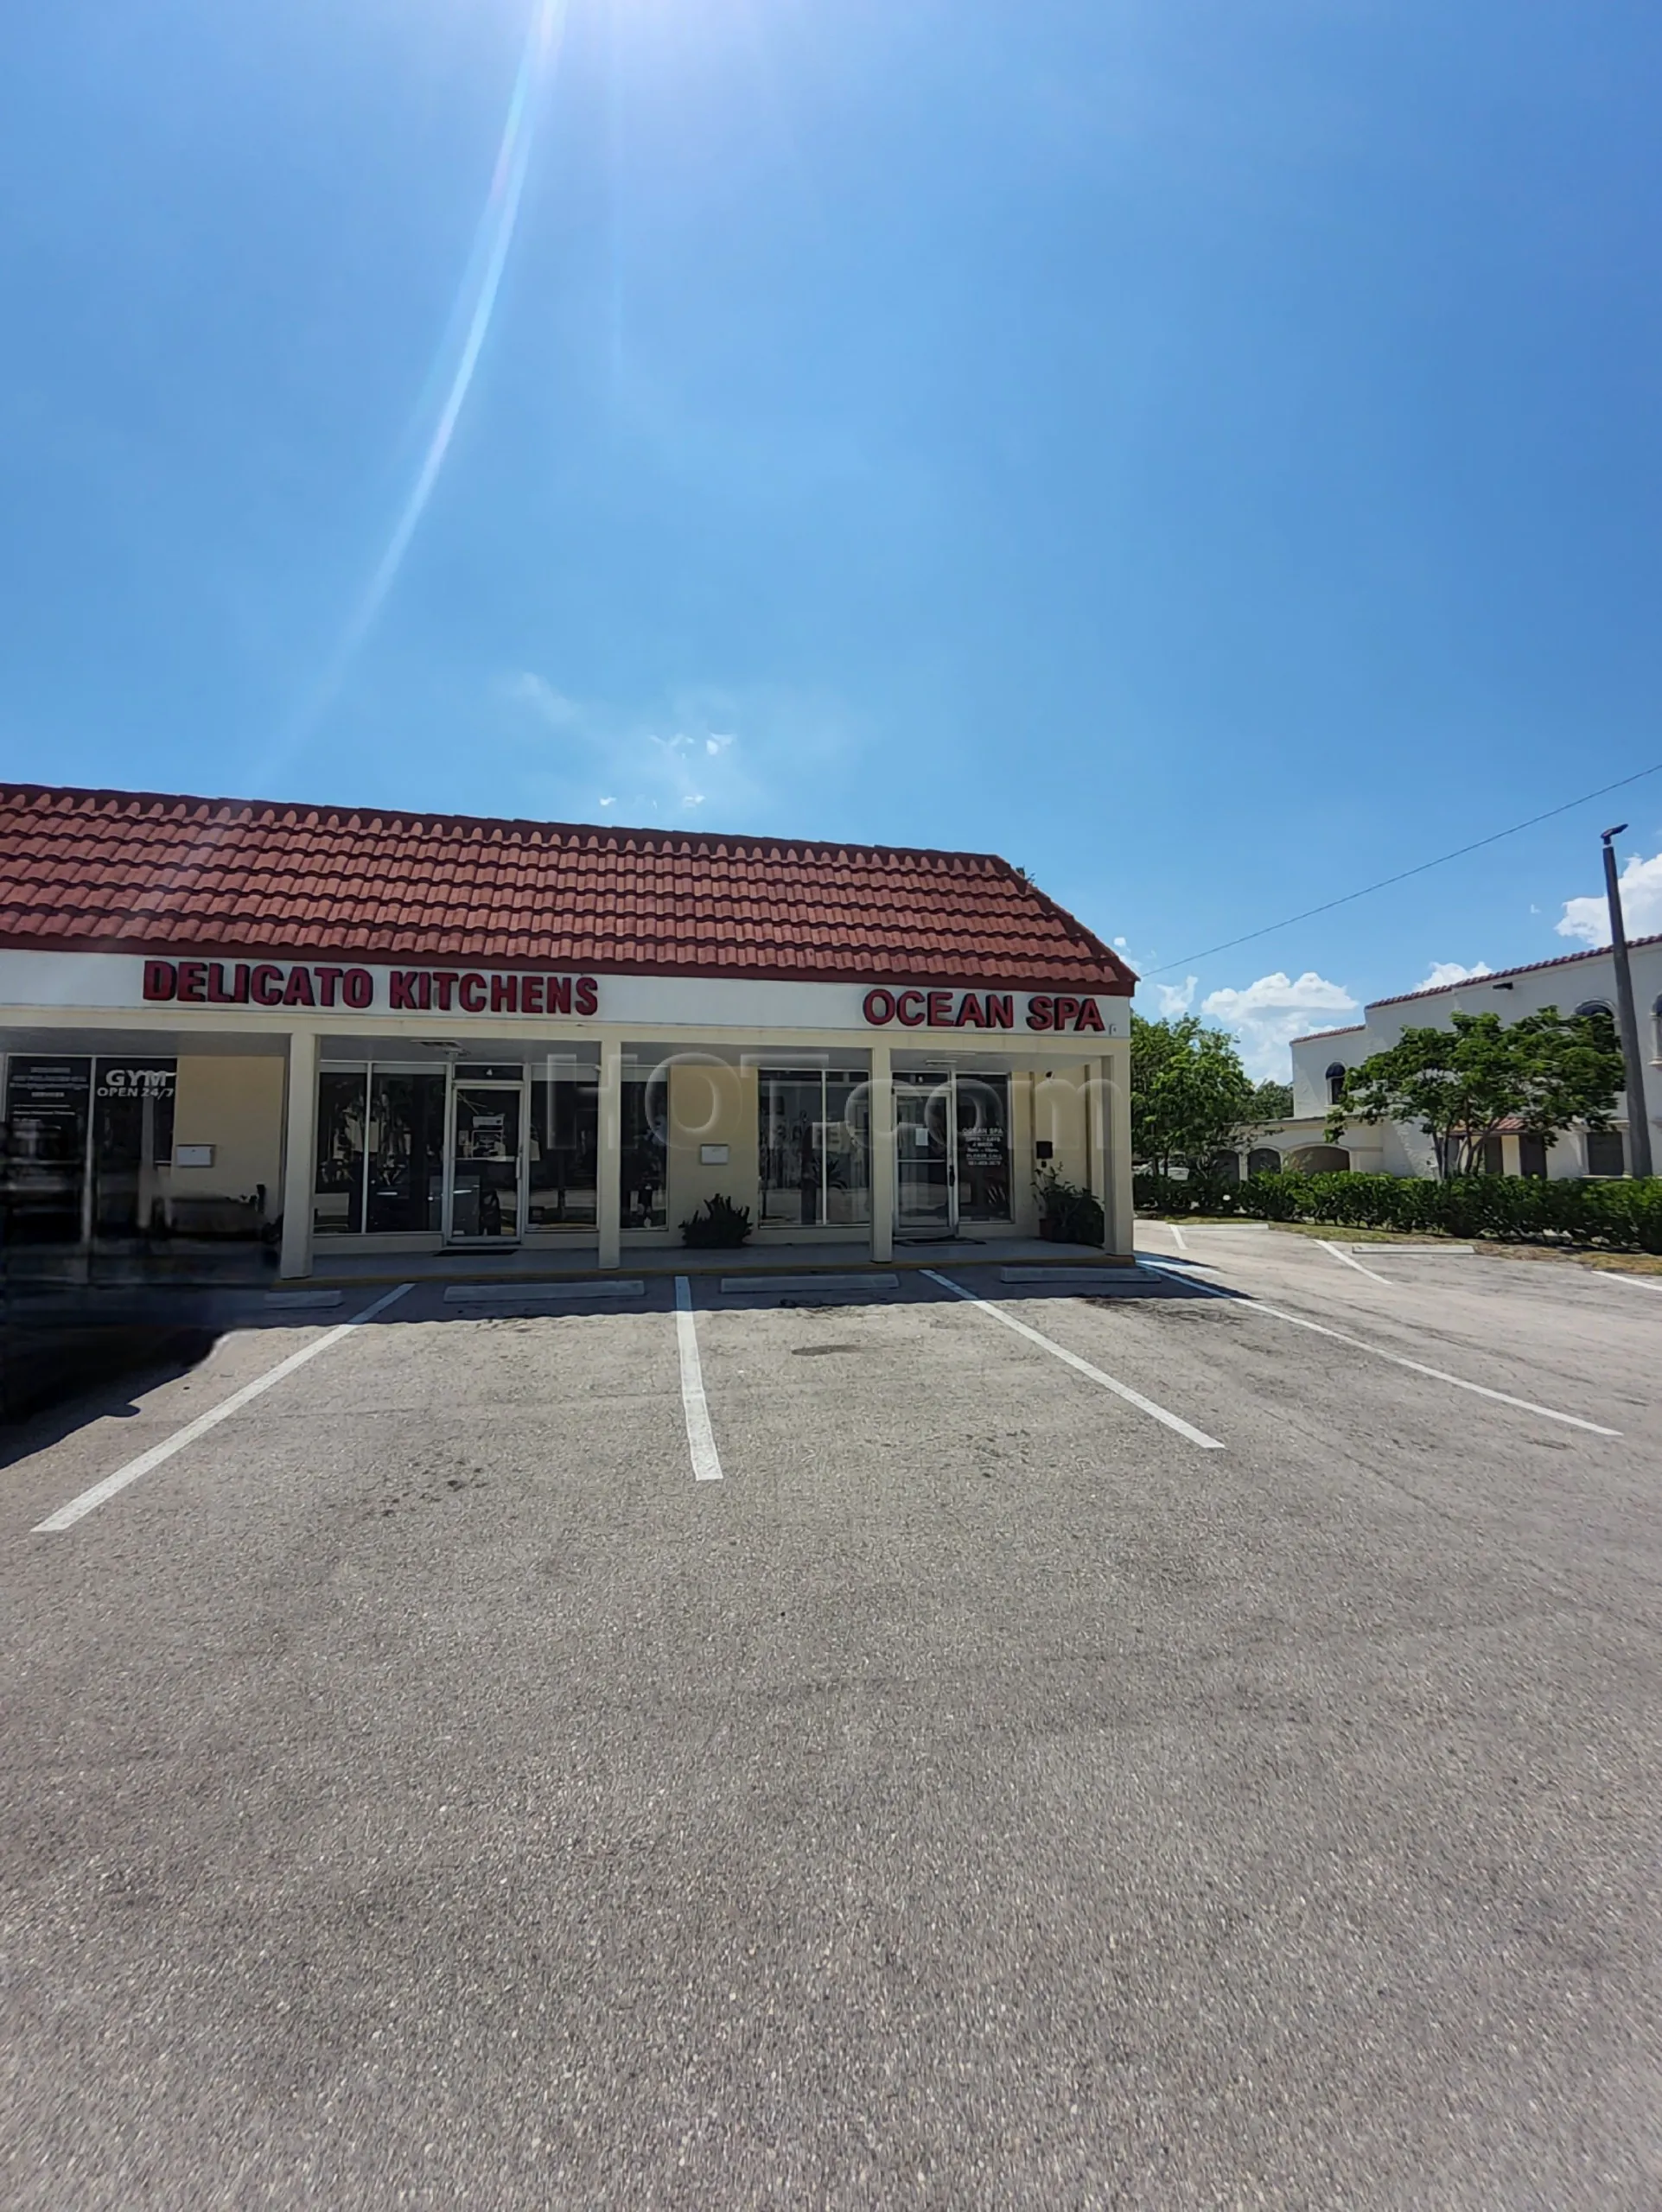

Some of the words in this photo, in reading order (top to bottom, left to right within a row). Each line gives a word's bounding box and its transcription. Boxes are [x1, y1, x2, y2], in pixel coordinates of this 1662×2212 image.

[143, 960, 373, 1009] DELICATO
[389, 970, 598, 1016] KITCHENS
[863, 988, 1014, 1028] OCEAN
[1026, 995, 1105, 1032] SPA
[97, 1086, 138, 1097] OPEN
[141, 1087, 174, 1101] 24/7
[105, 1069, 167, 1087] GYM
